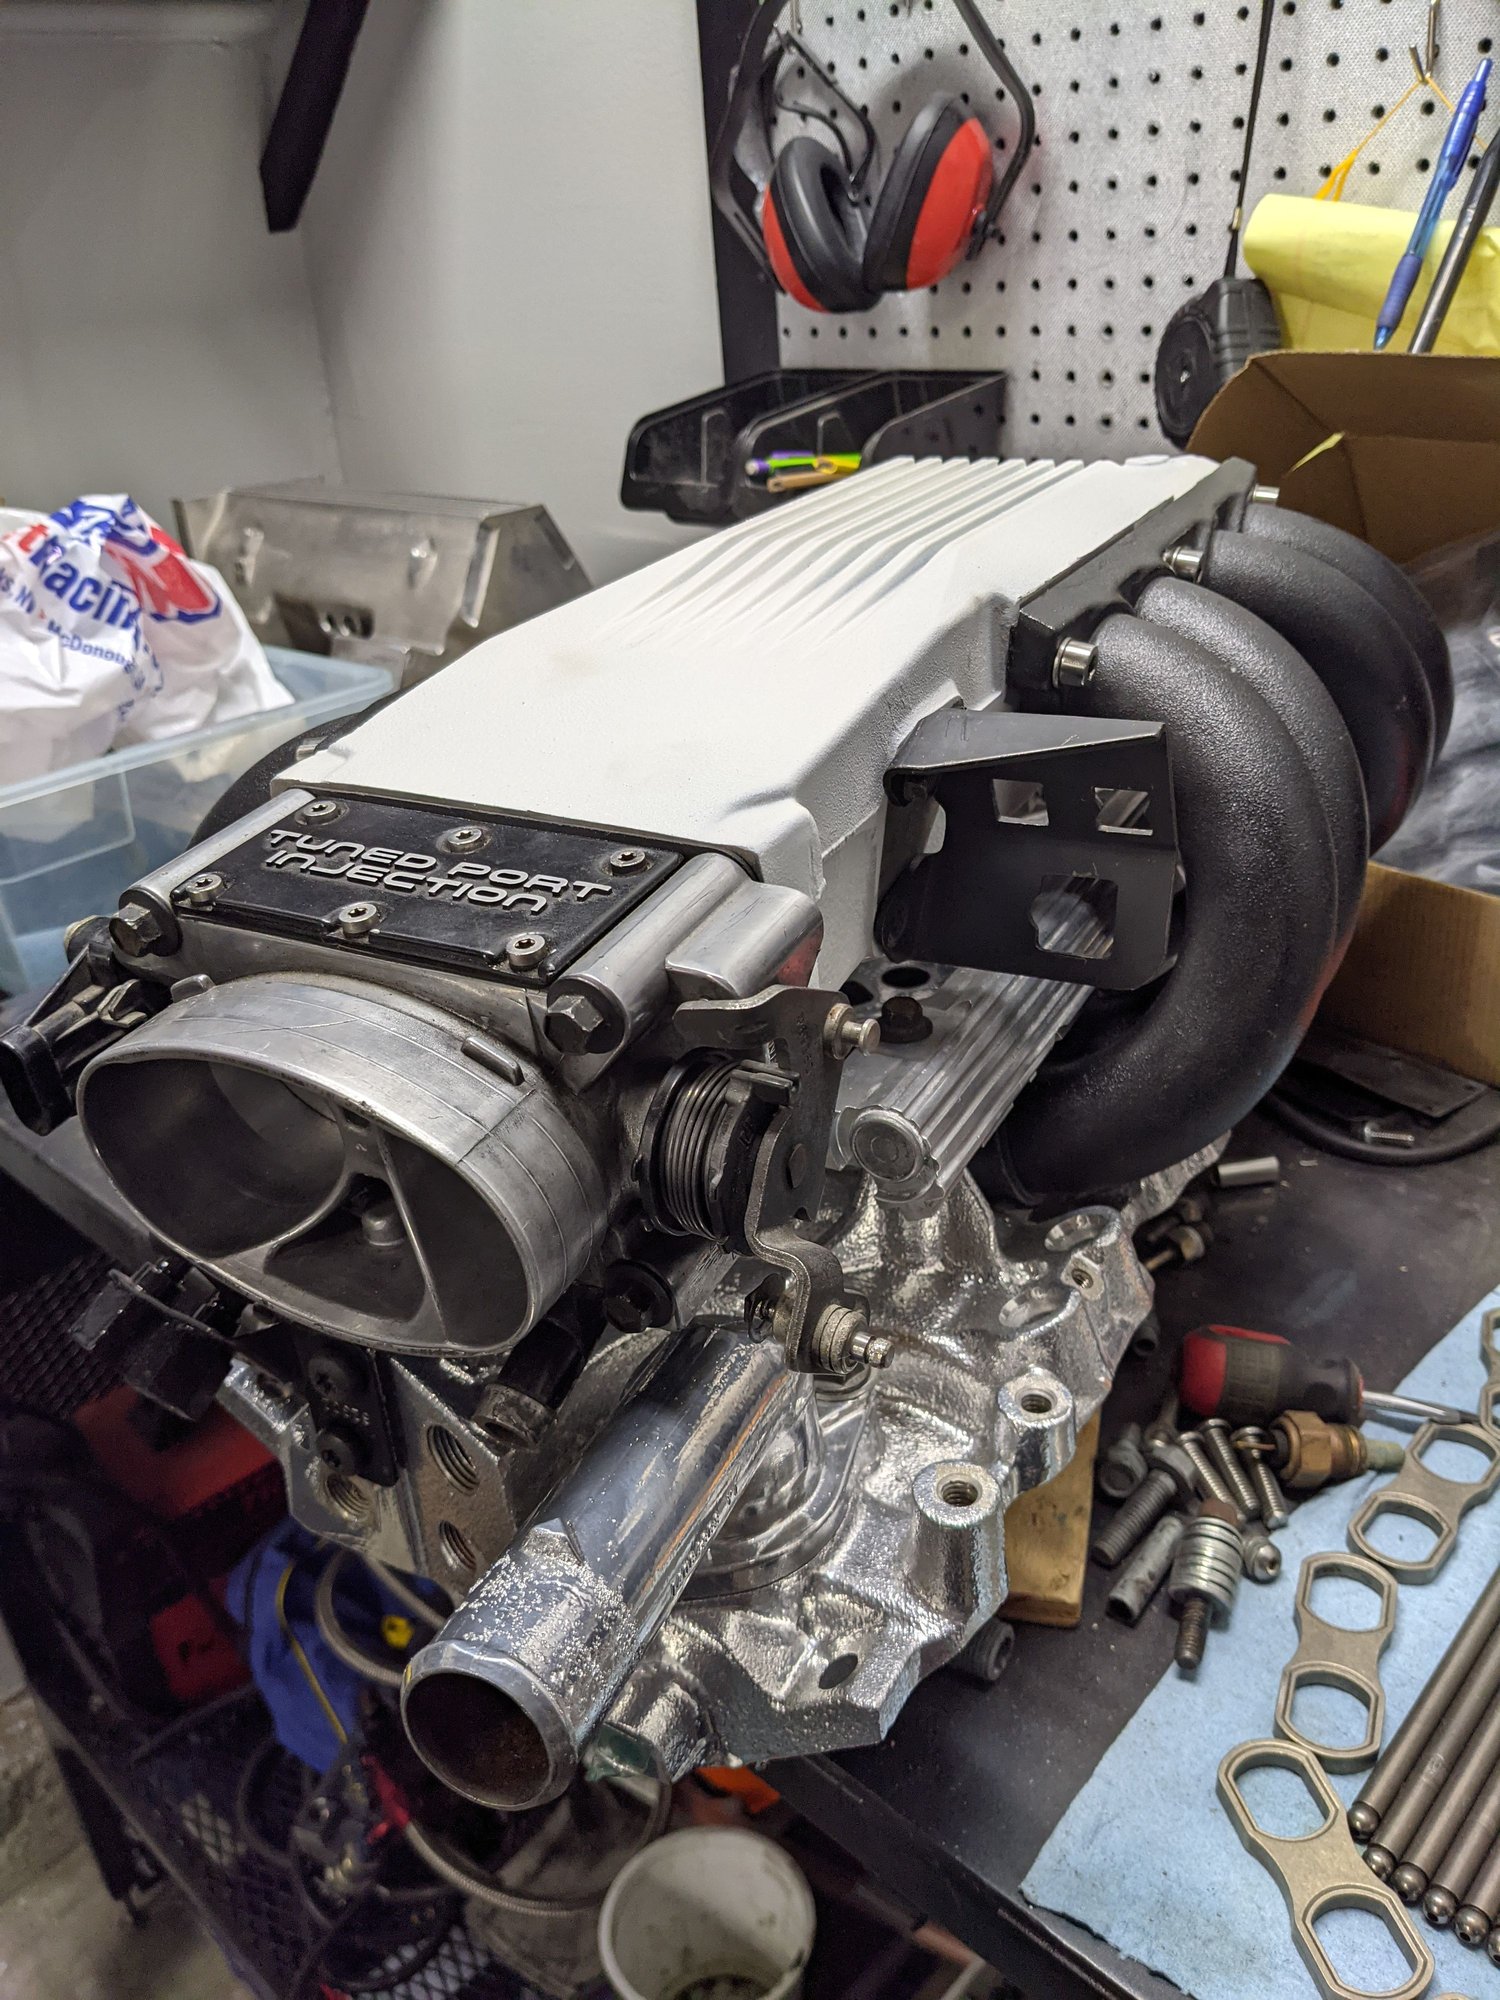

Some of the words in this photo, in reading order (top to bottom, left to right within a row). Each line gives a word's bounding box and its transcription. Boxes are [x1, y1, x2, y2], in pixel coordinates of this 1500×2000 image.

[265, 849, 547, 915] INJECTION
[270, 829, 438, 872] TUNED
[447, 861, 612, 901] PORT
